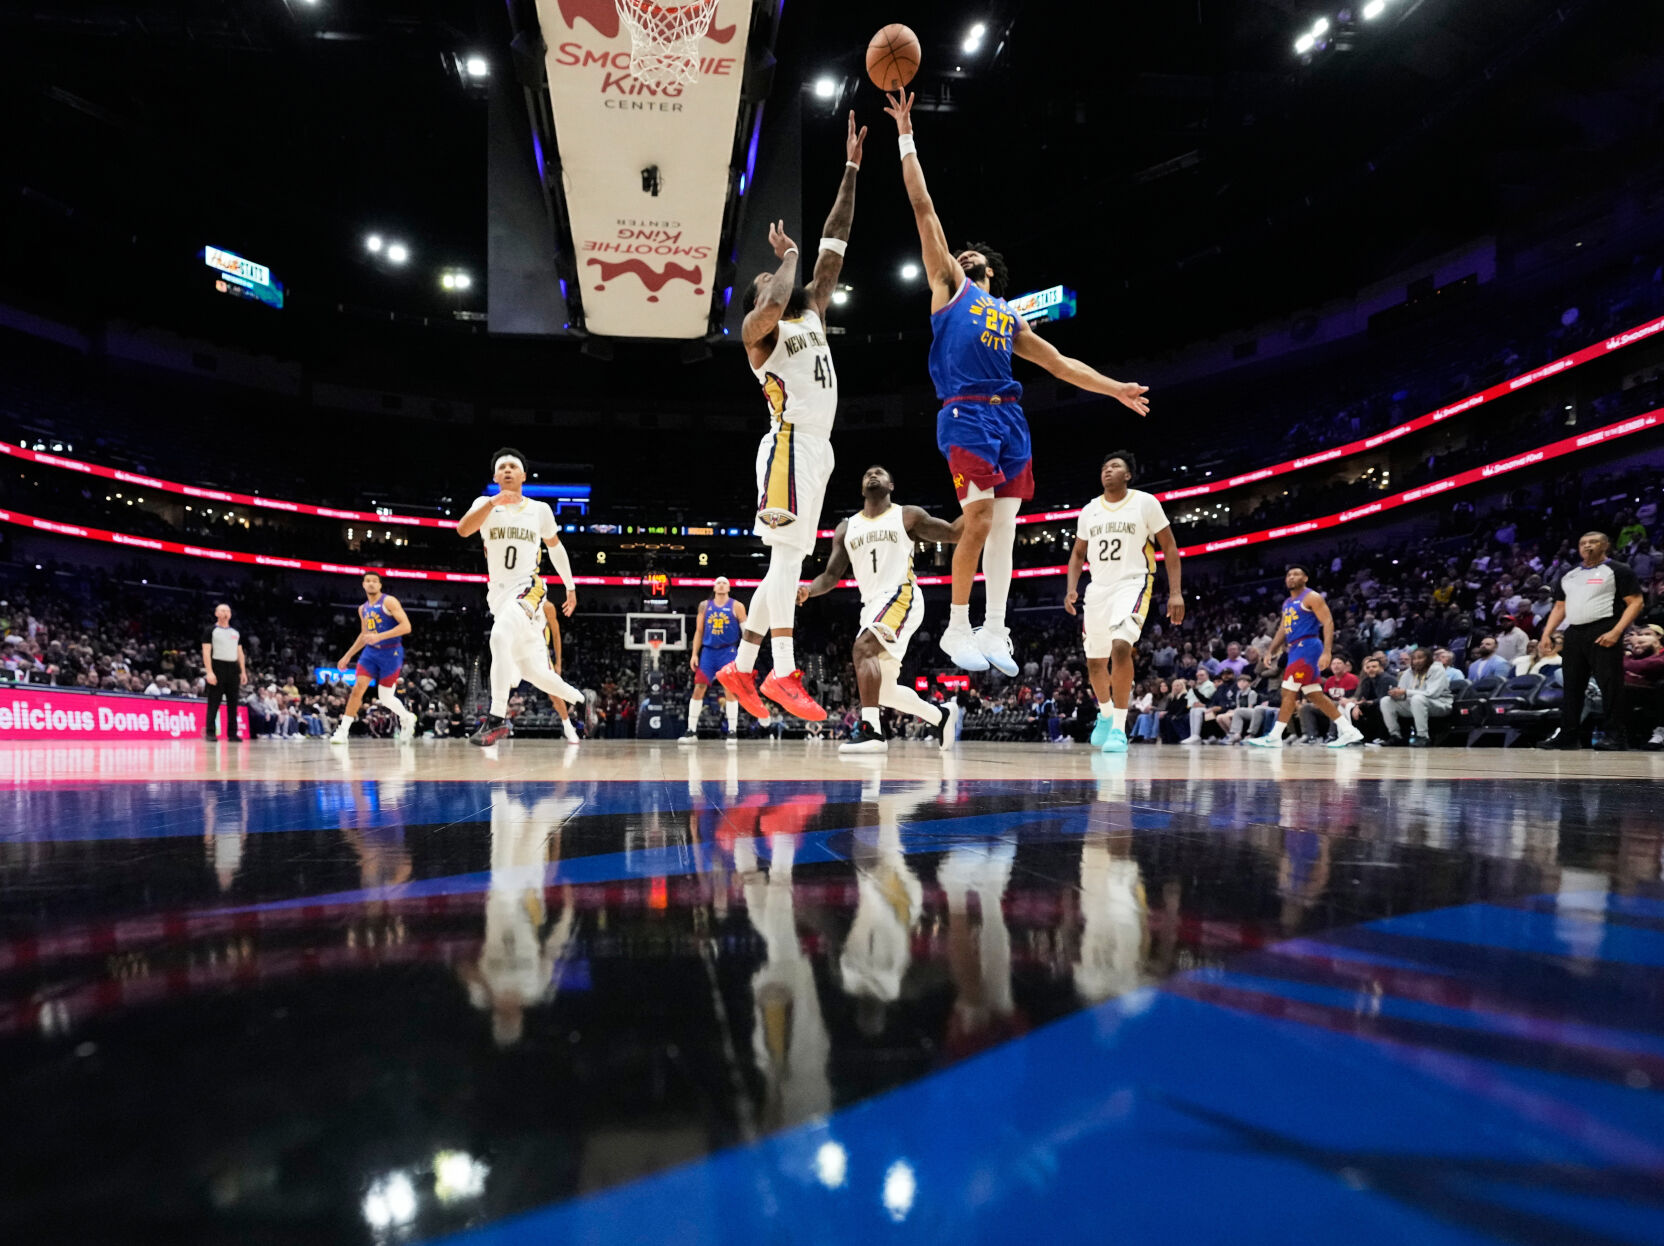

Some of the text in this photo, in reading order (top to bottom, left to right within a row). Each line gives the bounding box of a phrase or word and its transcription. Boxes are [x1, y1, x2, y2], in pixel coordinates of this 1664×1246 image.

[555, 42, 736, 75] SMOHIE
[604, 99, 683, 112] CENTER
[582, 240, 712, 259] SMOOTHIE
[986, 308, 1009, 336] 27
[784, 335, 808, 357] NEW
[981, 331, 1007, 350] CITY
[814, 355, 832, 388] 41
[489, 526, 506, 541] NEW
[867, 530, 898, 544] ORLEANS
[1105, 521, 1136, 535] ORLEANS
[504, 545, 517, 570] 0
[870, 548, 877, 573] 1
[1099, 538, 1121, 561] 22
[0, 701, 197, 737] elicious Done Right
